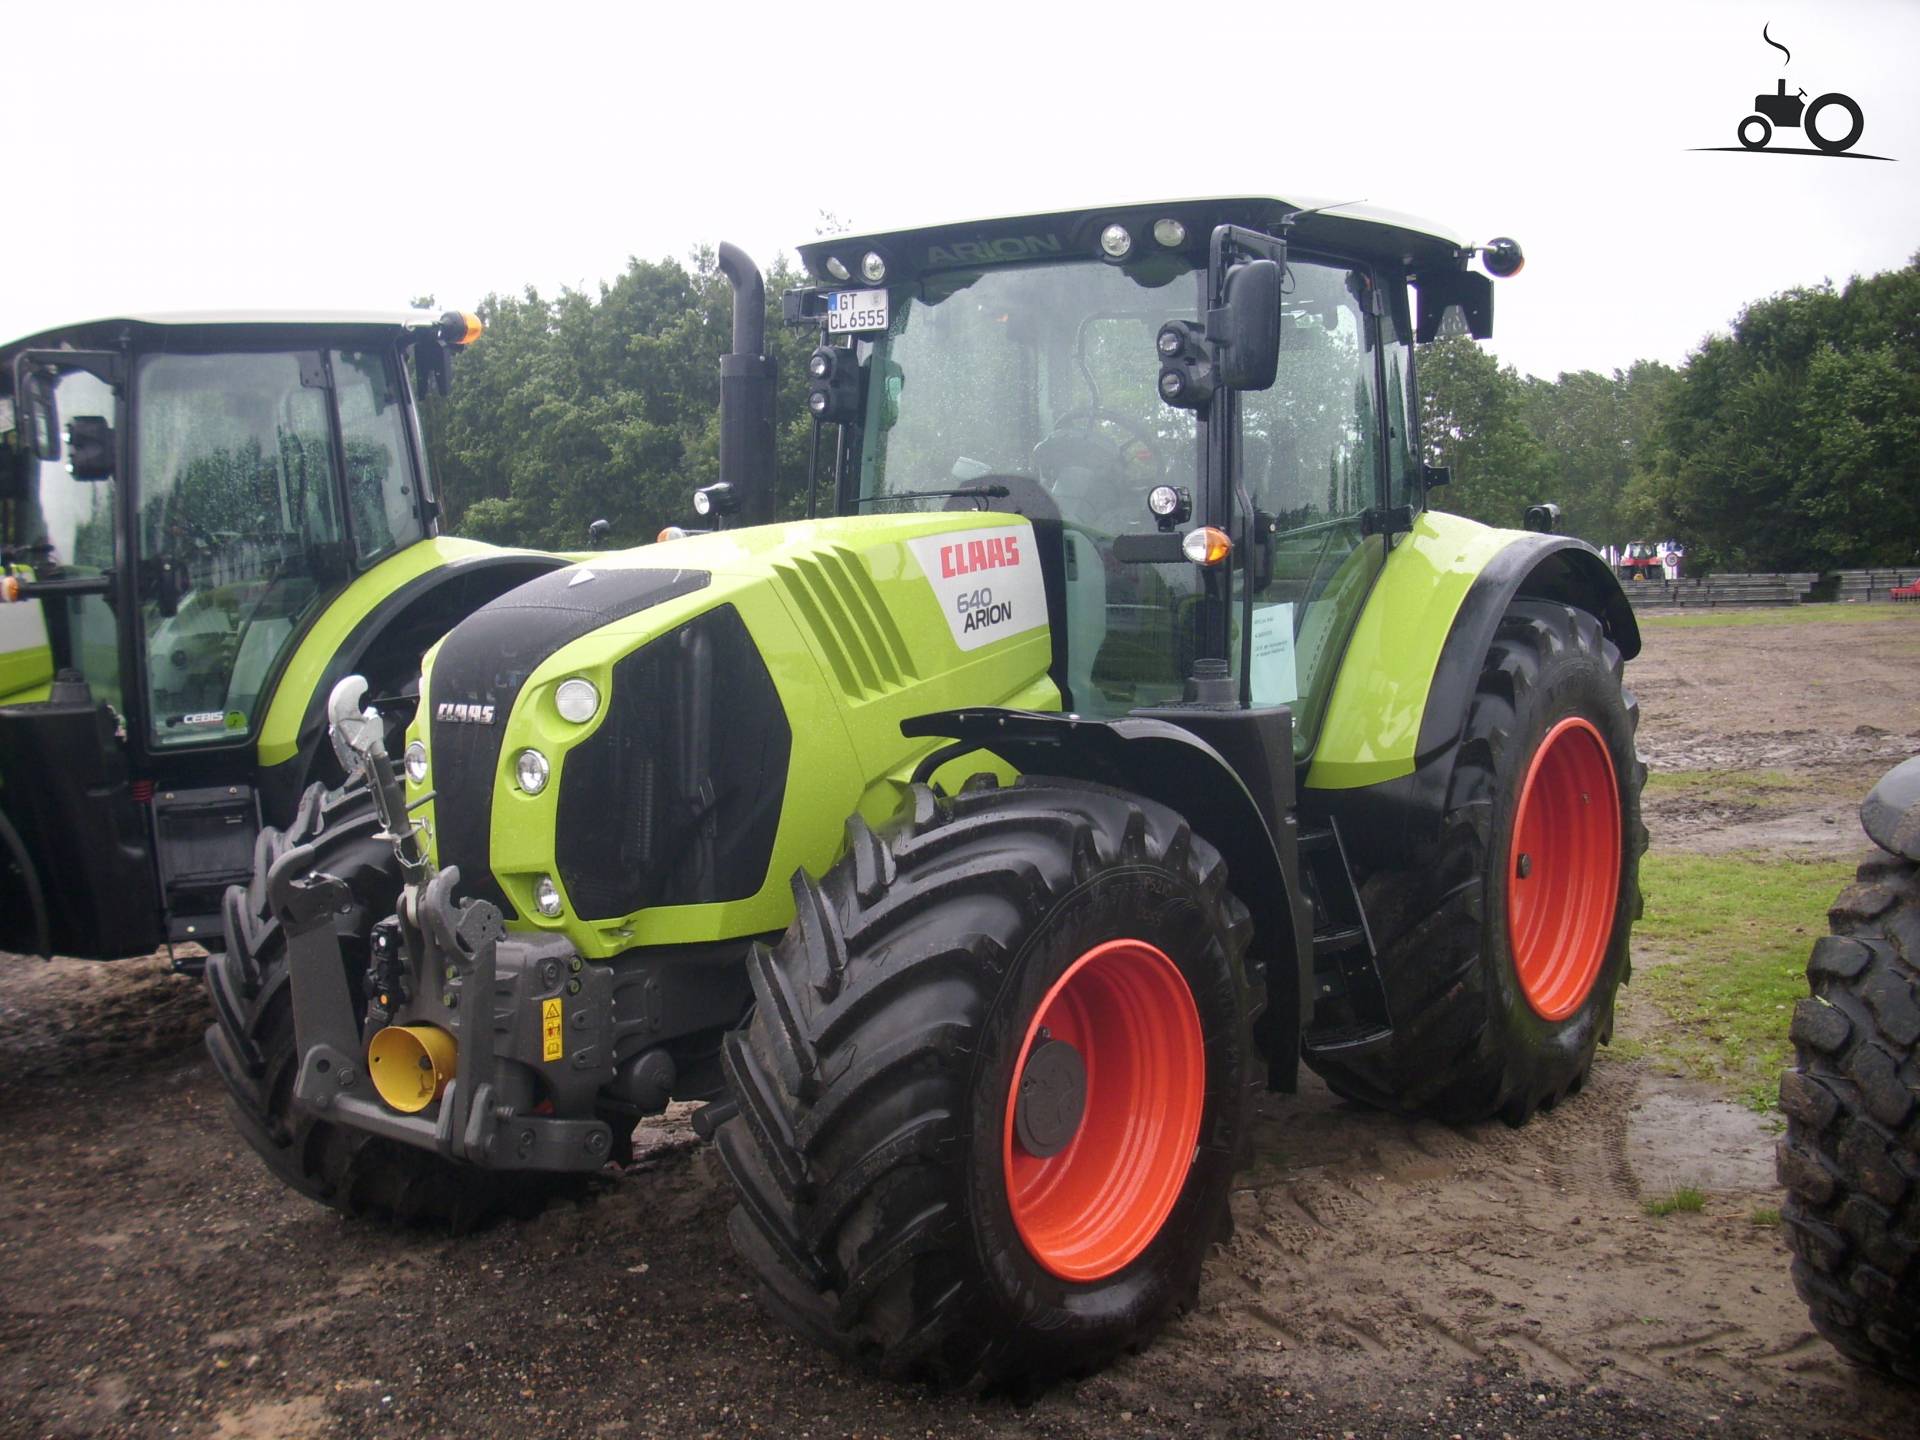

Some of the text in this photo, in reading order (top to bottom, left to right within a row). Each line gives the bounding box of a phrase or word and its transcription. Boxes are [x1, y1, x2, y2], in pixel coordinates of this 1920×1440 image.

[840, 293, 857, 311] GT
[830, 309, 885, 330] CL 6555
[940, 536, 1020, 579] CLAAS
[957, 587, 992, 614] 640
[963, 600, 1012, 634] ARION
[183, 711, 224, 724] CEBIS
[436, 703, 496, 725] CLAAS
